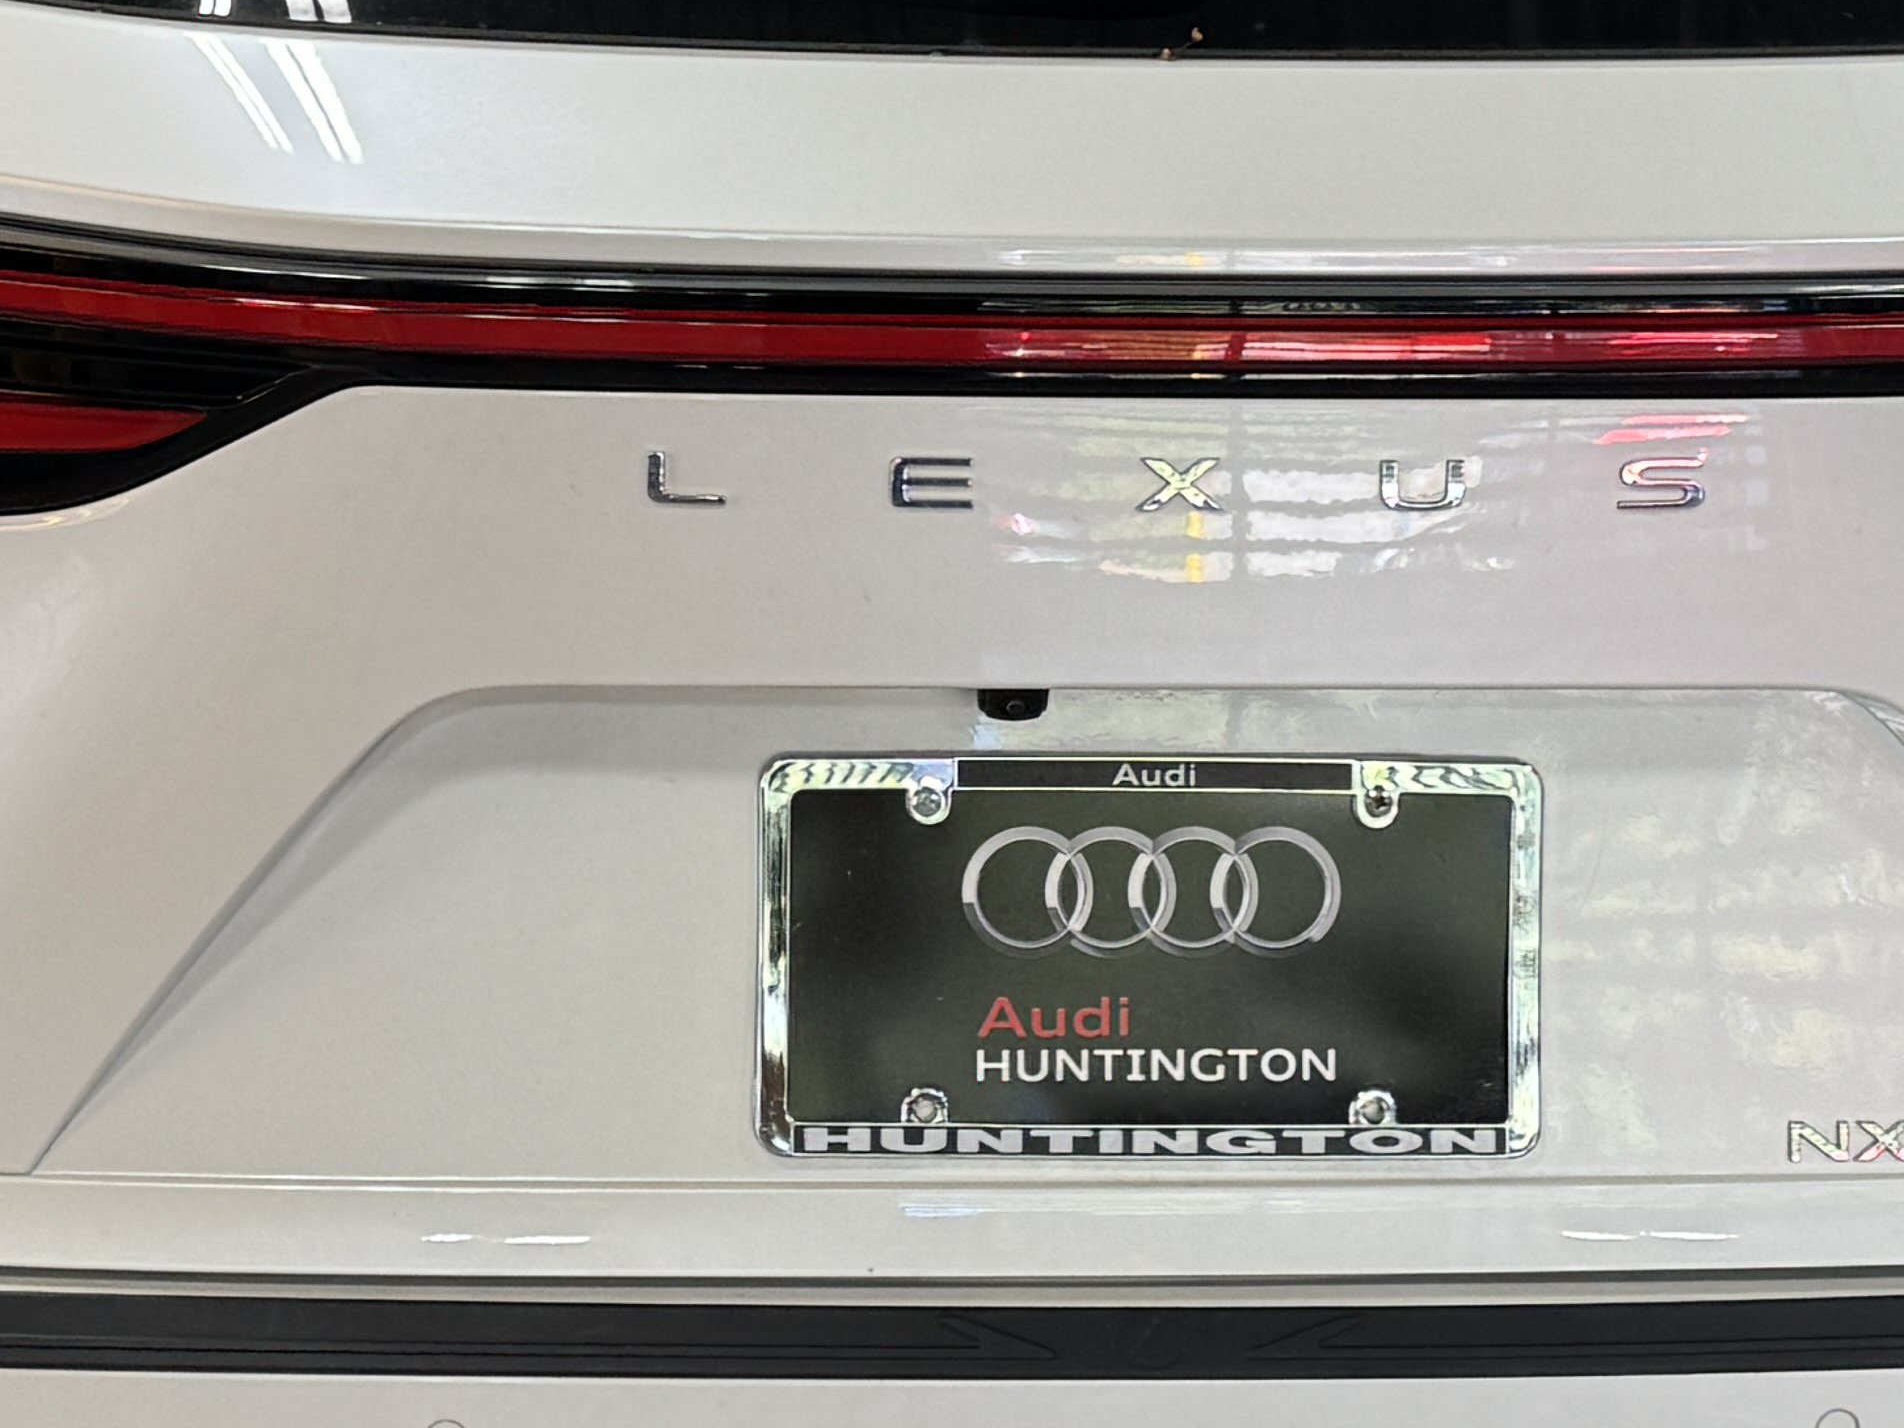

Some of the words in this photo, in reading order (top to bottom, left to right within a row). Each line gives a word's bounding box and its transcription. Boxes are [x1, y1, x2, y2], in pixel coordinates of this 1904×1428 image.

[647, 450, 1708, 511] LEXUS
[1113, 763, 1197, 788] Audi
[977, 996, 1130, 1038] Audi
[976, 1048, 1337, 1083] HUNTINGTON
[802, 1126, 1498, 1155] HUNTINGTON
